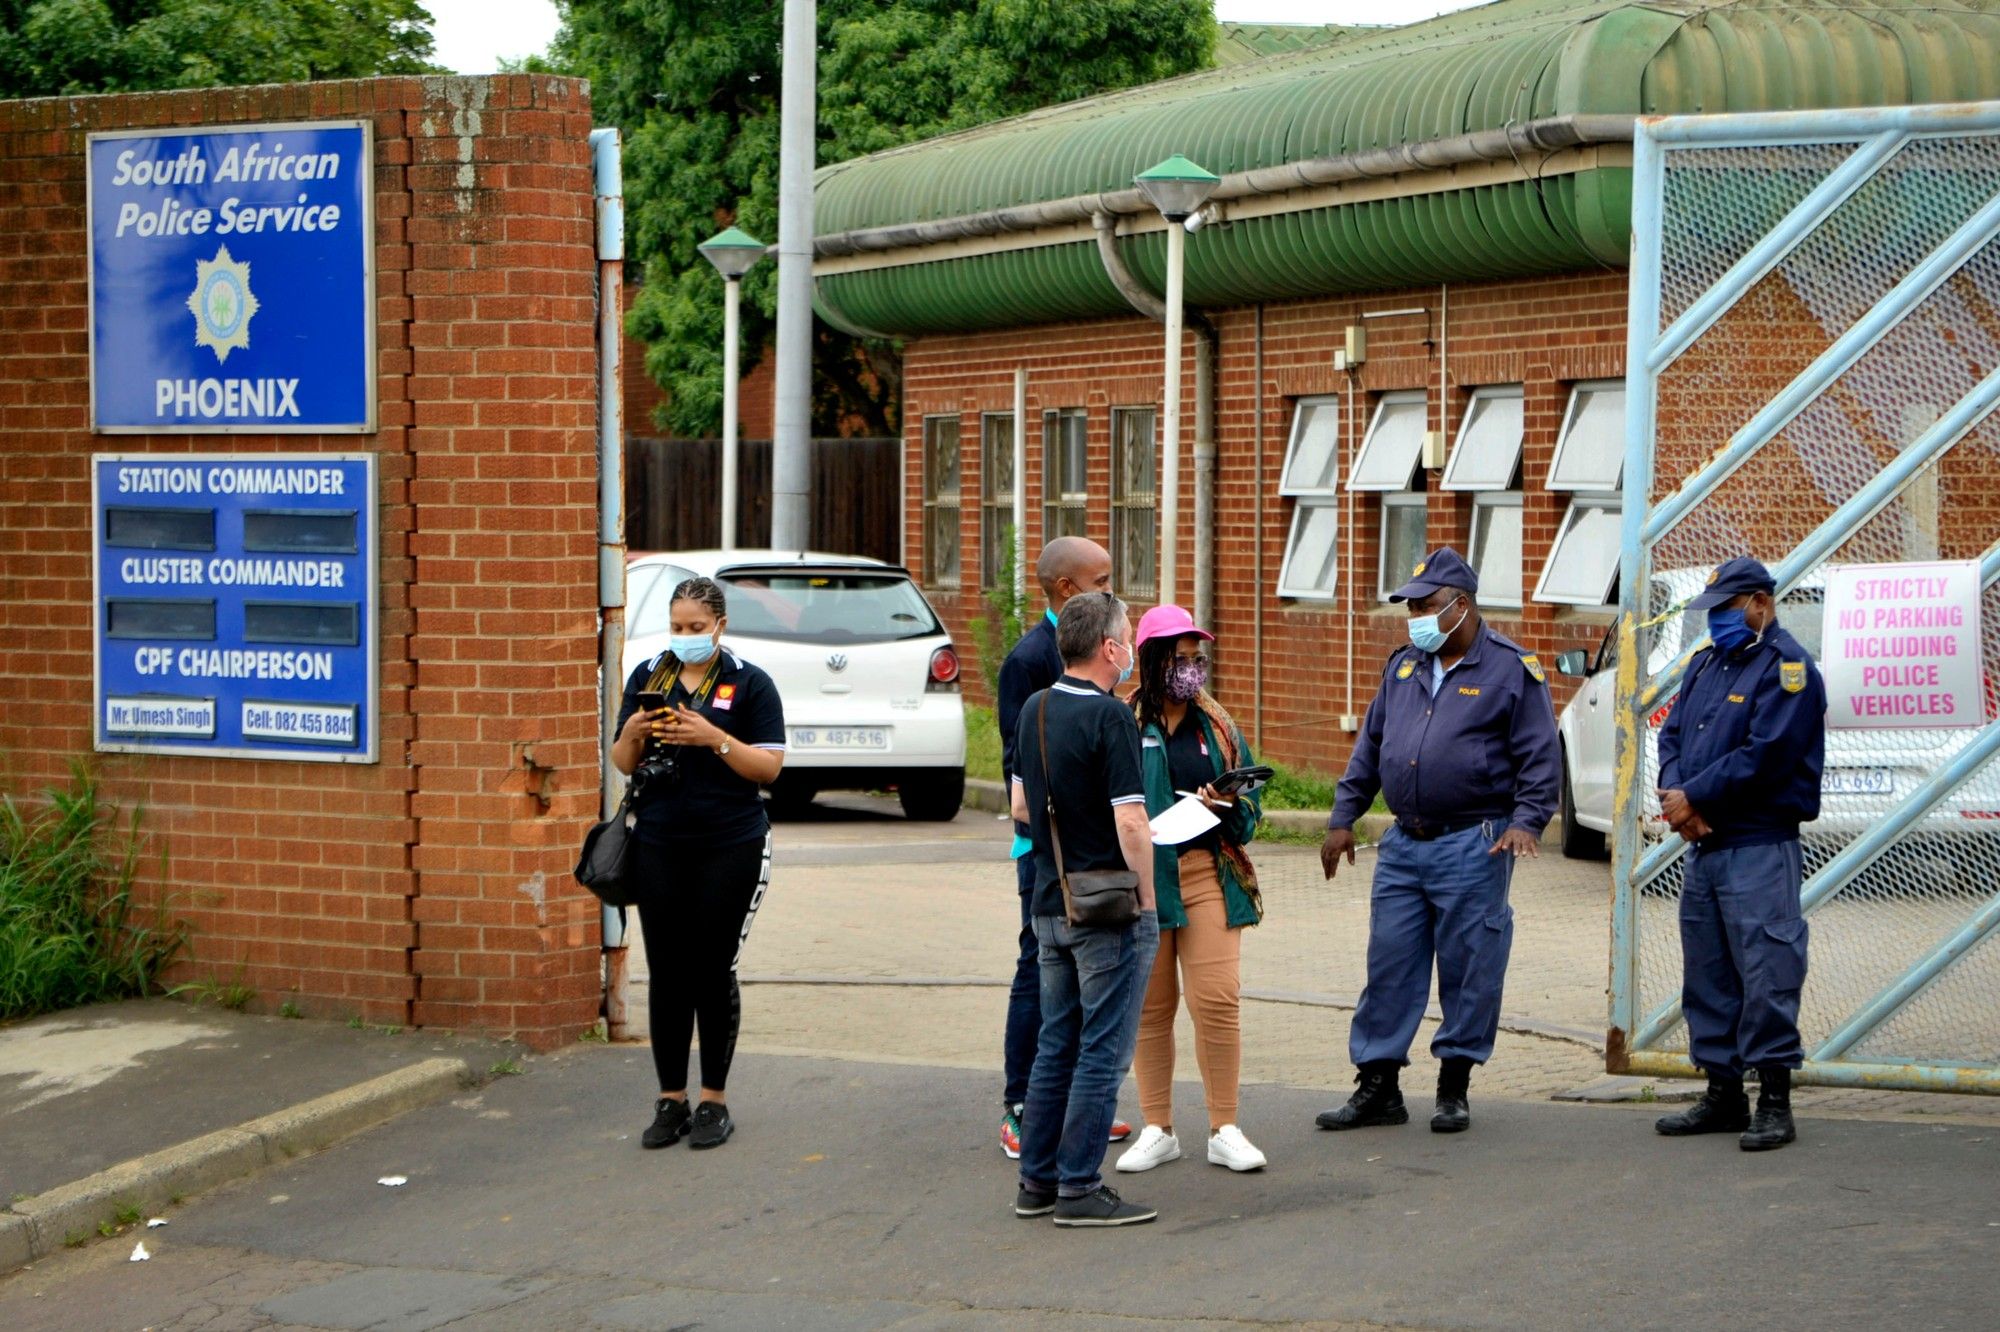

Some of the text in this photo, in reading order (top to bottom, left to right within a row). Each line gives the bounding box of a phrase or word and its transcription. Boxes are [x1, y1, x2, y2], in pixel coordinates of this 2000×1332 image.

[112, 142, 340, 187] South African
[115, 192, 341, 239] Police Service
[155, 376, 301, 418] PHOENIX
[118, 466, 345, 496] STATION COMMANDER
[121, 557, 345, 588] CLUSTER COMMANDER
[1855, 577, 1948, 601] STRICTLY
[1839, 605, 1964, 630] NO PARKING
[1844, 635, 1958, 659] INCLUDING
[134, 646, 333, 681] CPF CHAIRPERSON
[1863, 664, 1939, 688] POLICE
[1459, 688, 1480, 696] POLICE
[111, 706, 211, 729] Mr. Umesh Singh
[1851, 693, 1955, 717] VEHICLES
[246, 708, 352, 737] Cell: 082 455 8841
[794, 730, 817, 745] ND
